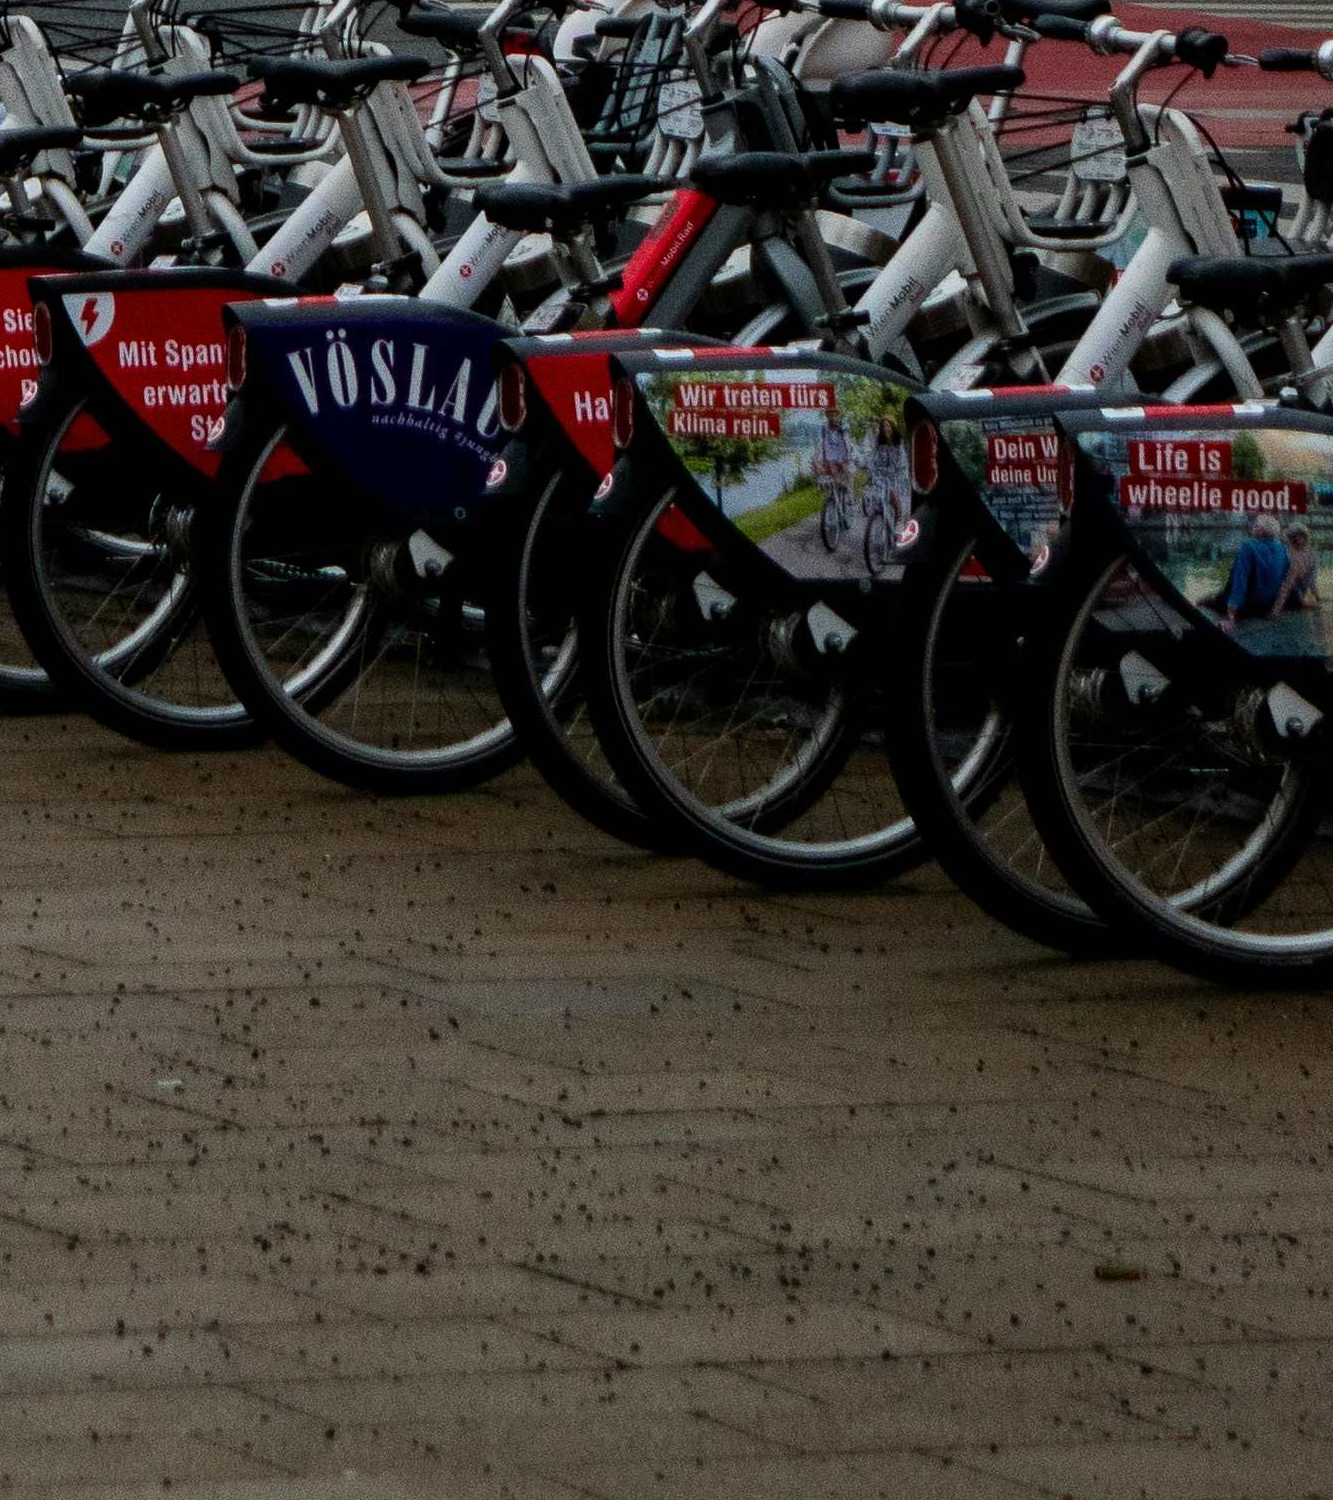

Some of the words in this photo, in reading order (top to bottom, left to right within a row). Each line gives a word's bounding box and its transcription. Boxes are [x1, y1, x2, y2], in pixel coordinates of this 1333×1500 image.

[2, 308, 33, 333] Sie
[118, 341, 157, 369] Mit
[679, 384, 717, 407] Wir
[722, 384, 783, 407] treten
[788, 383, 829, 408] fürs
[672, 413, 727, 435] Klima
[733, 415, 776, 436] rein.
[993, 438, 1036, 462] Dein
[1137, 442, 1189, 474] Life
[1199, 442, 1222, 474] is
[991, 465, 1032, 484] deine
[1126, 479, 1223, 510] wheelie
[1230, 485, 1299, 512] good.
